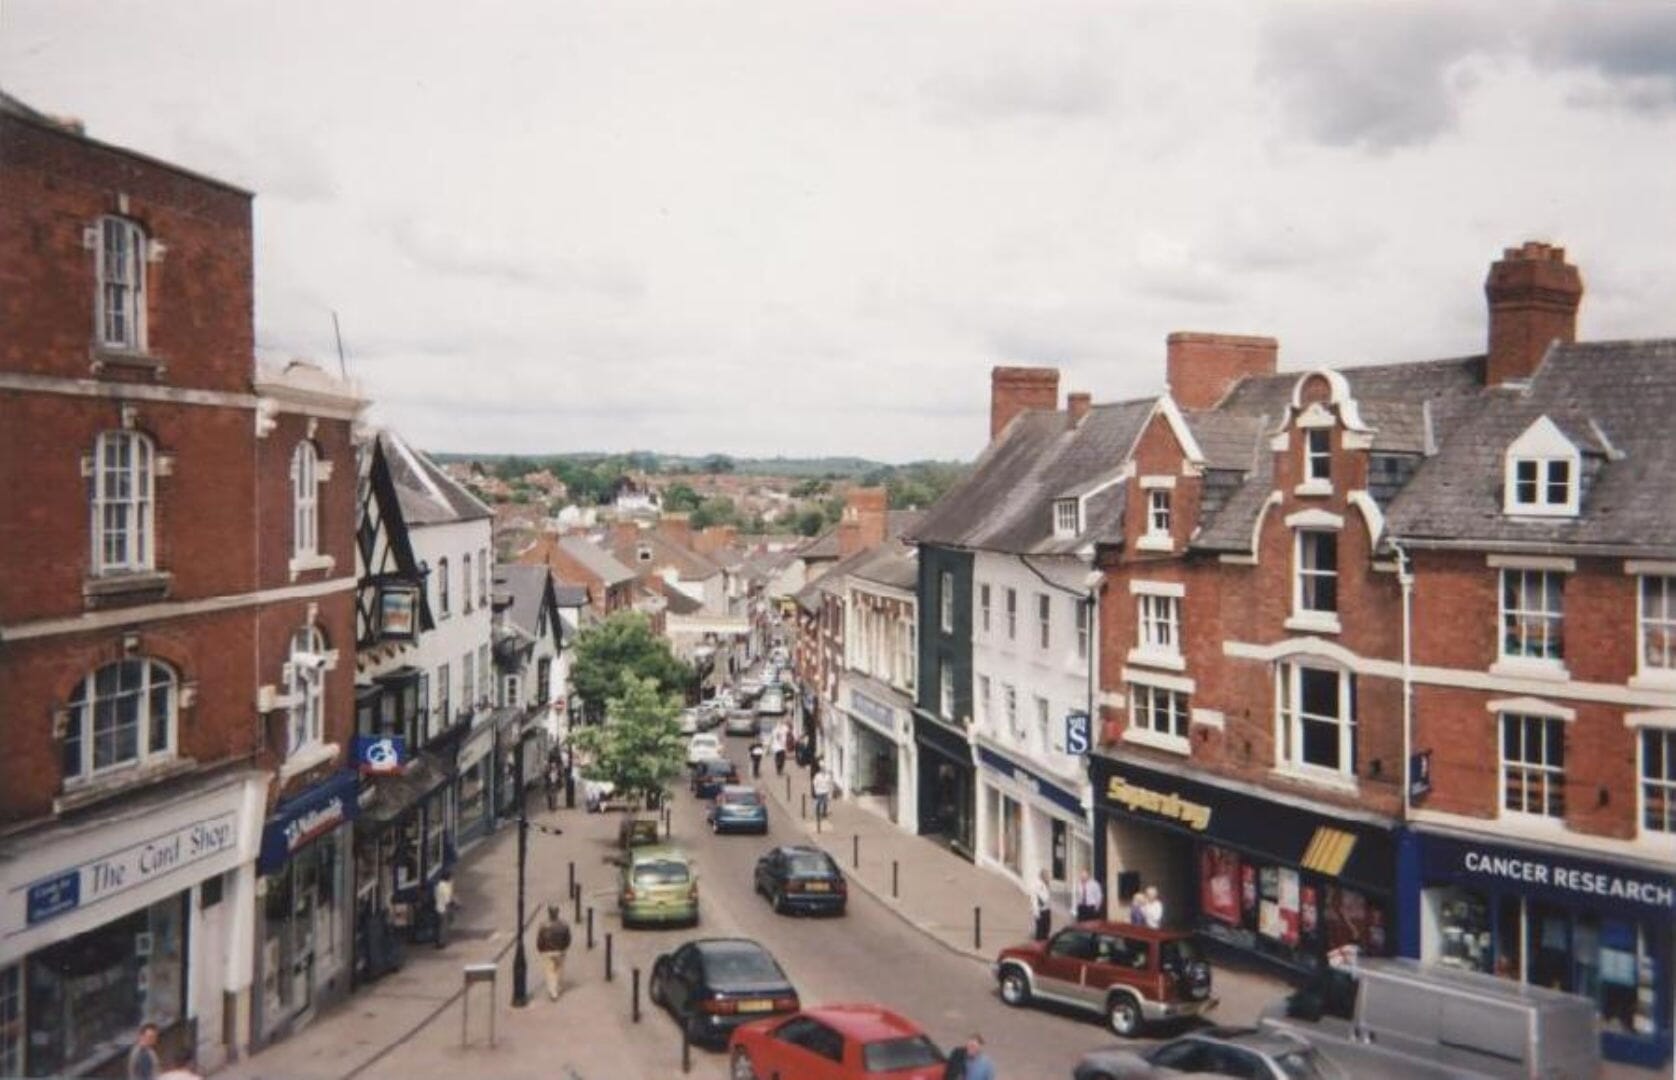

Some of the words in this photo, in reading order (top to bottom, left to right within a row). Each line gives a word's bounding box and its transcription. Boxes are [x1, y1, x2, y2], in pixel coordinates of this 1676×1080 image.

[91, 862, 126, 895] The
[139, 836, 180, 874] Card
[190, 823, 230, 855] Shop
[1465, 852, 1549, 884] CANCER
[1553, 866, 1673, 907] RESEARCH
